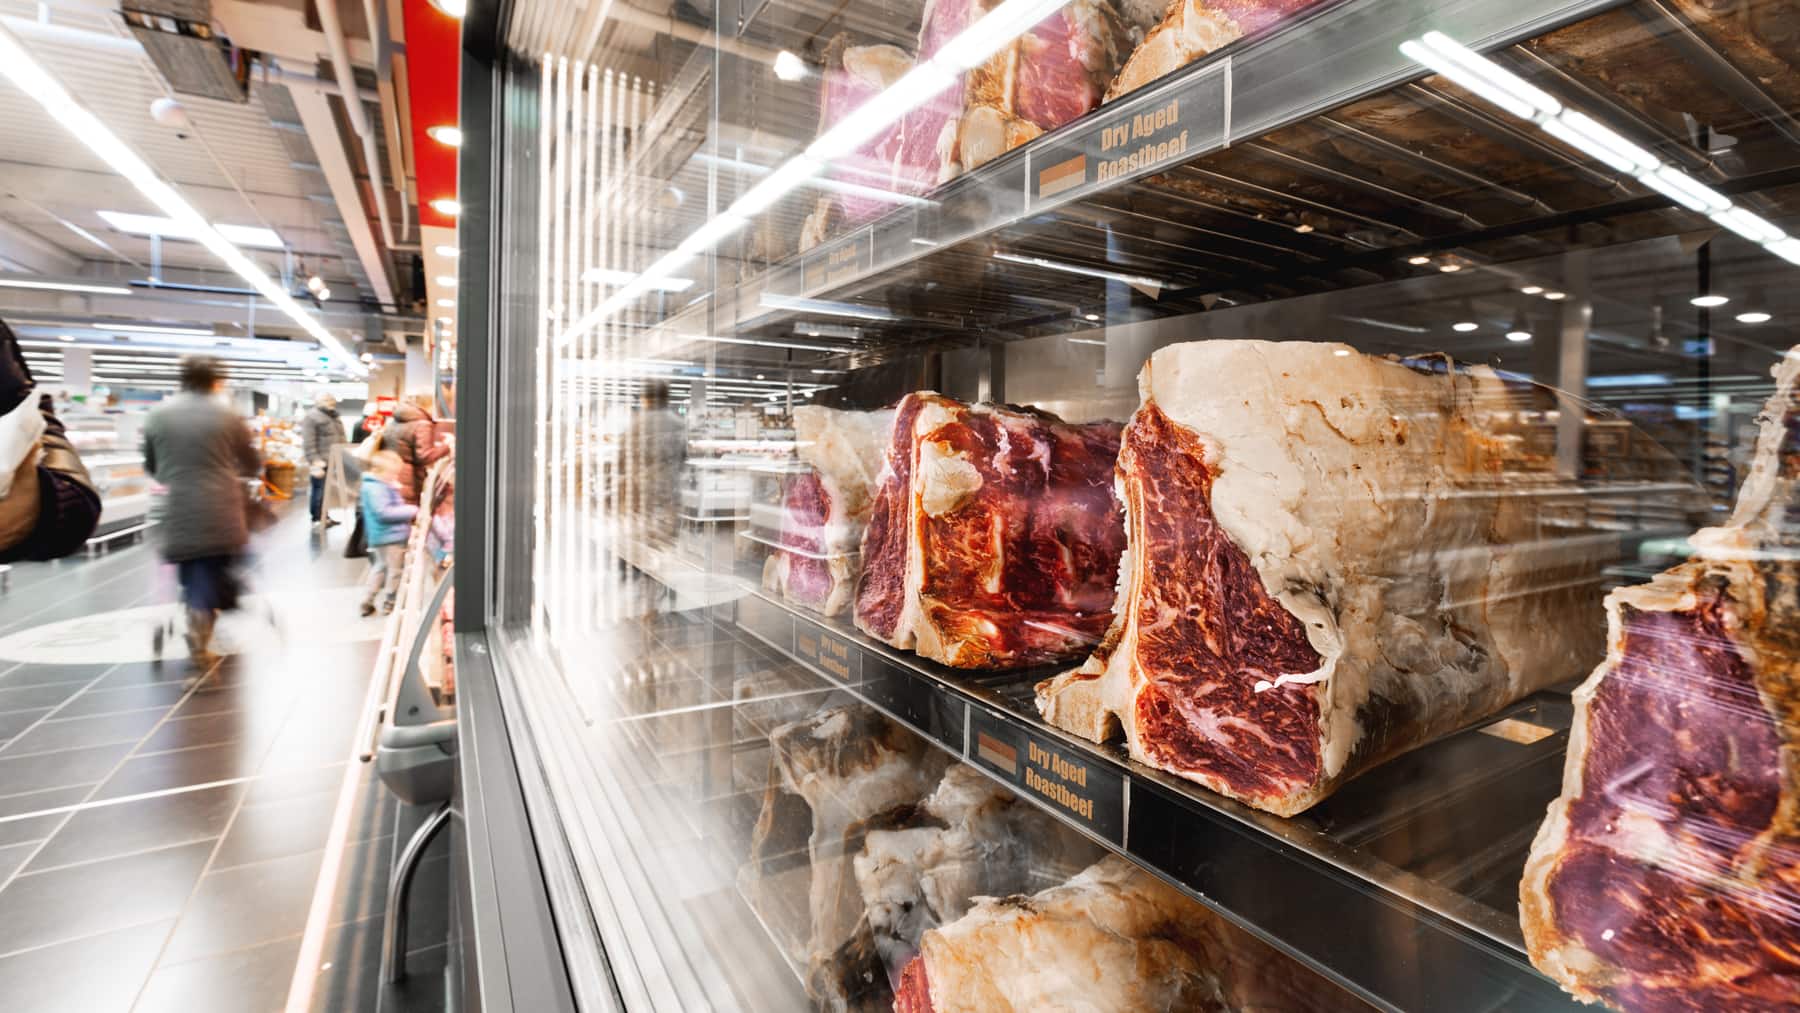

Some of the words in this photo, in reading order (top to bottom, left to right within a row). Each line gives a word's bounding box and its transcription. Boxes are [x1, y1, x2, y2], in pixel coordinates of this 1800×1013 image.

[1102, 123, 1130, 151] Dry
[1132, 100, 1179, 139] Aged
[1097, 131, 1188, 184] Roastbeef
[1028, 741, 1050, 770] Dry
[1052, 753, 1086, 787] Aged
[1026, 767, 1093, 820] Roastbeef
